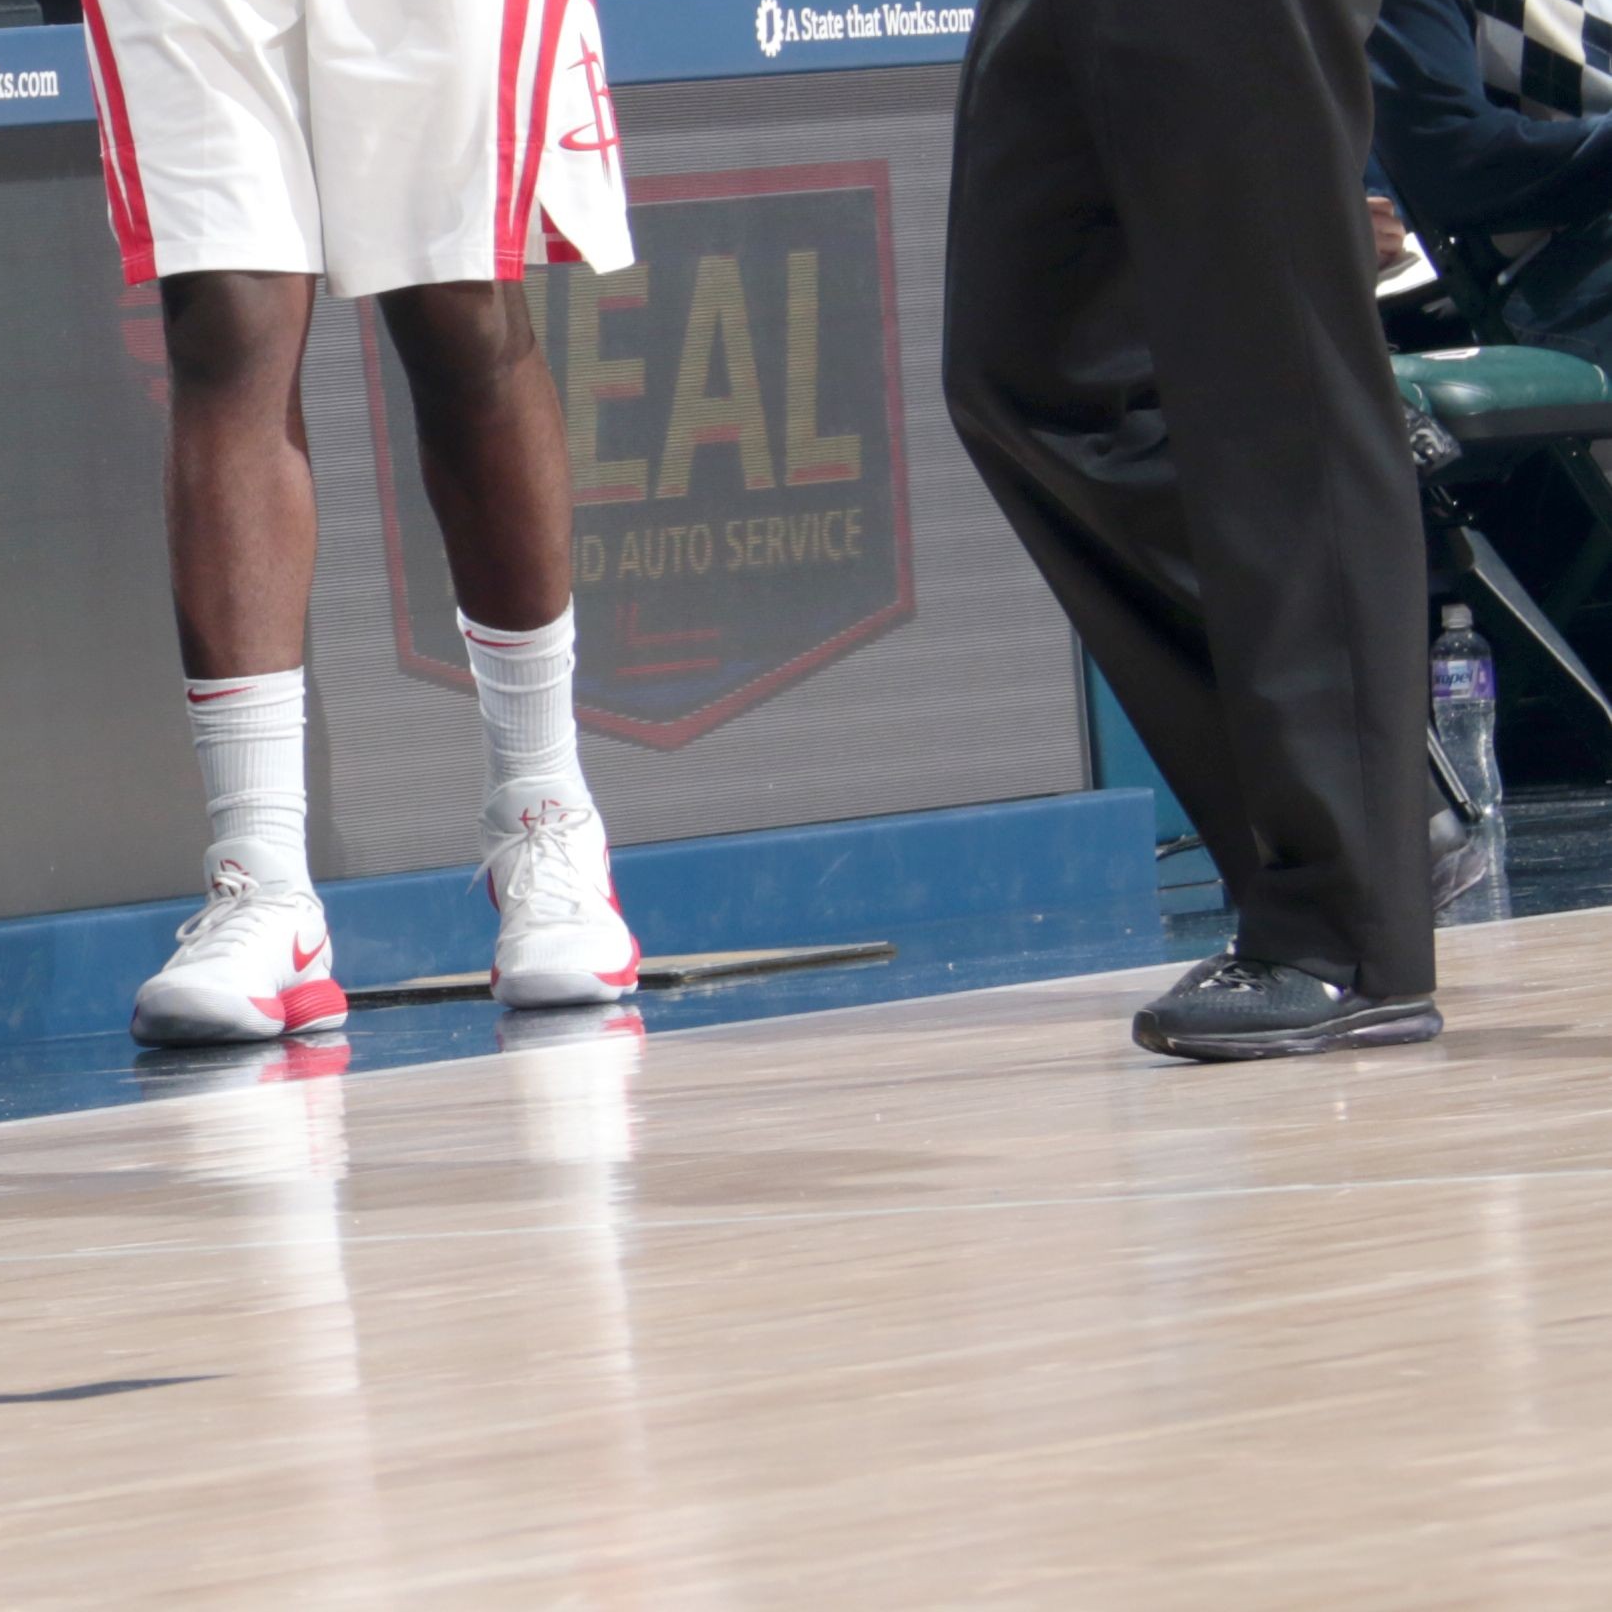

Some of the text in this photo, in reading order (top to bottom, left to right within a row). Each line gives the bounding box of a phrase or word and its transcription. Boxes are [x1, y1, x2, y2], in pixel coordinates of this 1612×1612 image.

[786, 1, 975, 42] A State that Works.com
[523, 250, 861, 508] EAL
[616, 526, 713, 582] AUTO
[725, 509, 862, 571] SERVICE
